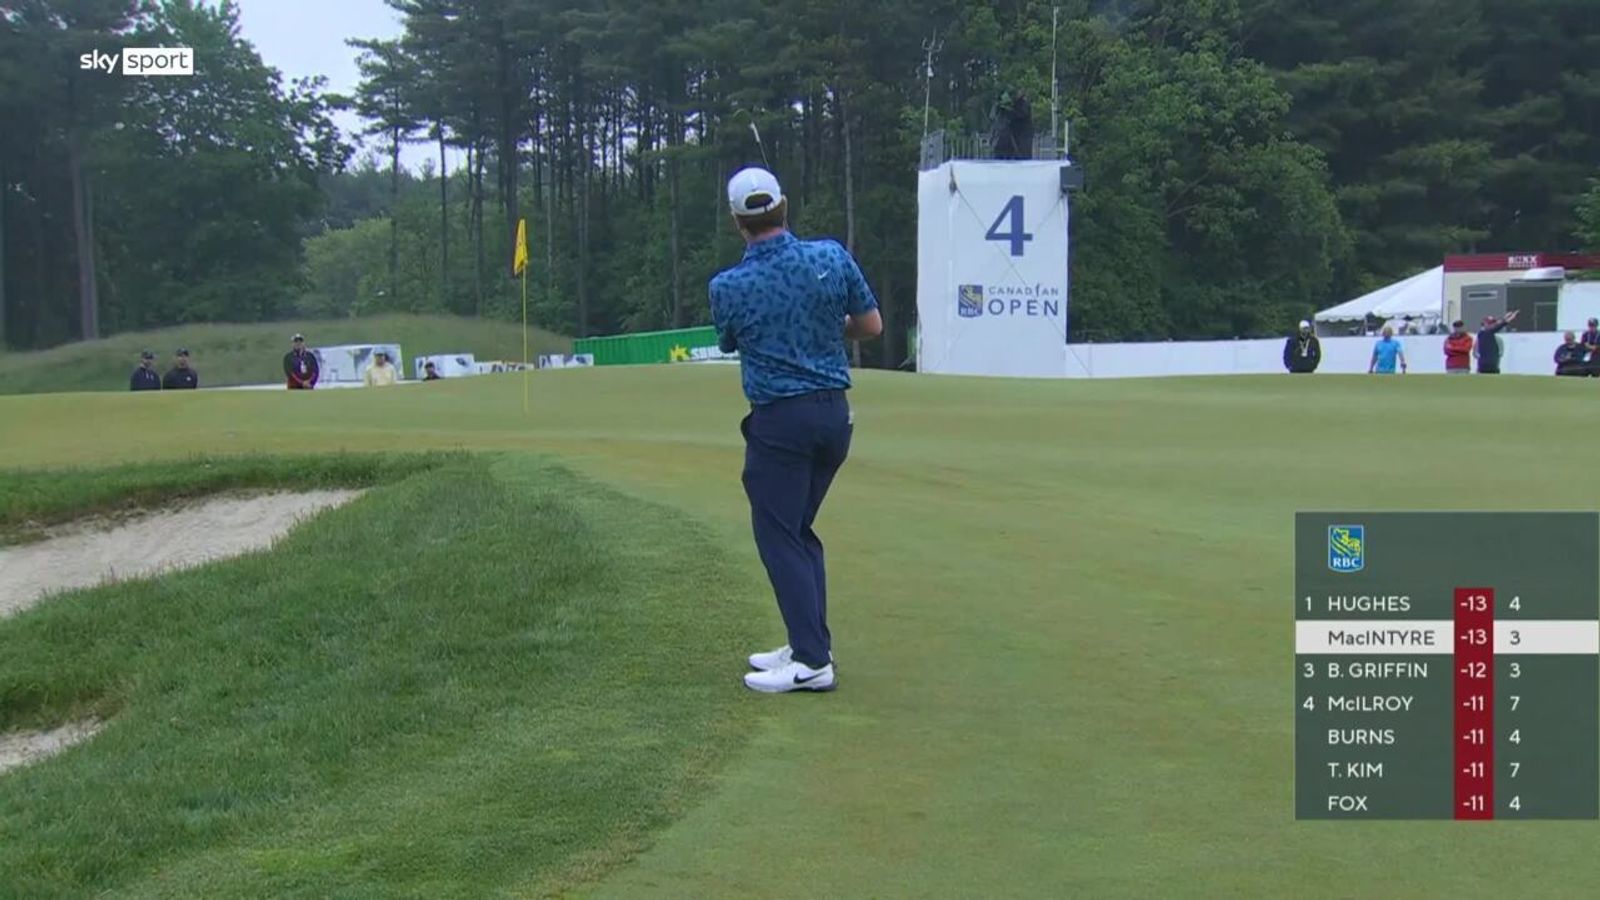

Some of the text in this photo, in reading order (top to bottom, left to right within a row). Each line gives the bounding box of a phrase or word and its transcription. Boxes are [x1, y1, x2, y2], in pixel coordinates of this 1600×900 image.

[985, 194, 1034, 257] 4
[988, 283, 1060, 297] CANADIAN
[987, 298, 1060, 317] OPEN
